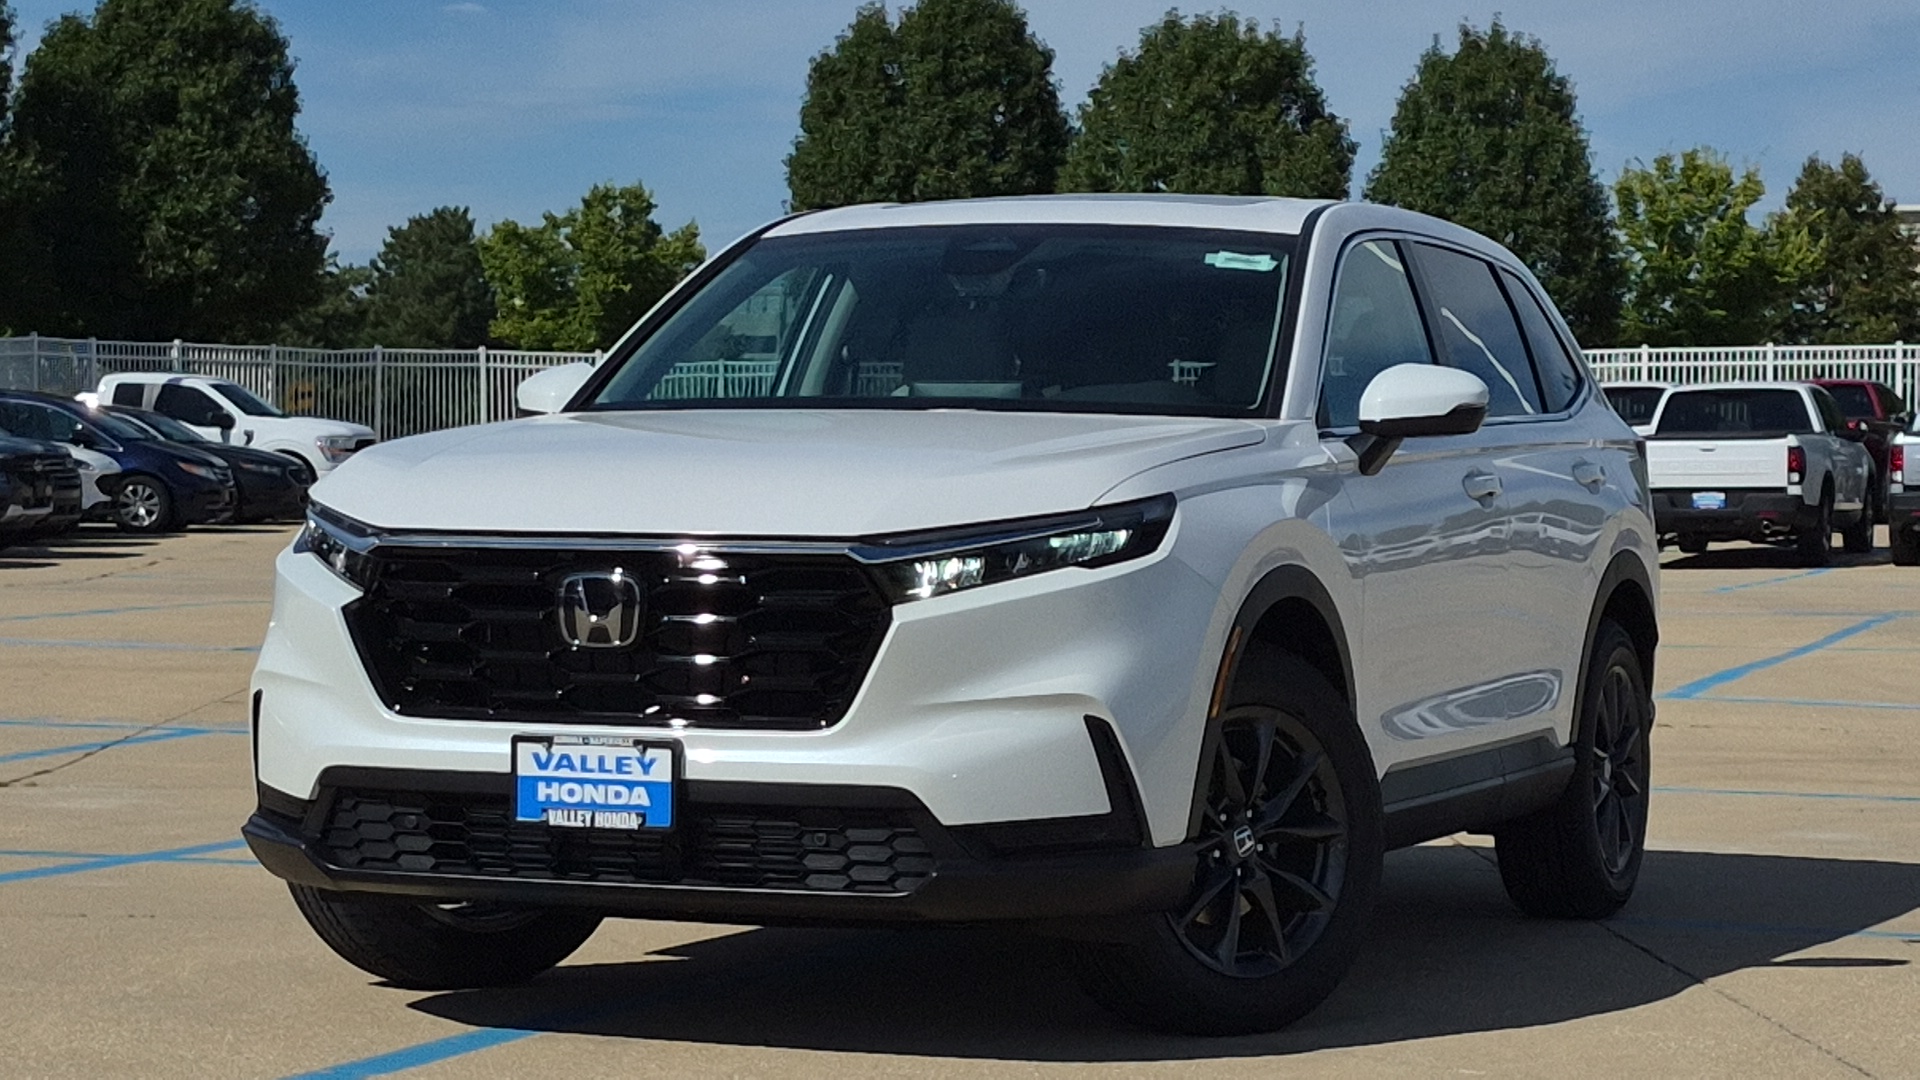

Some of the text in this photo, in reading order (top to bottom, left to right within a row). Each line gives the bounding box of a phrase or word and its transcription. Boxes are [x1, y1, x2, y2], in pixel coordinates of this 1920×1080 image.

[531, 752, 657, 776] VALLEY
[537, 781, 651, 806] HONDA
[549, 809, 639, 830] VALLEY HONDA
